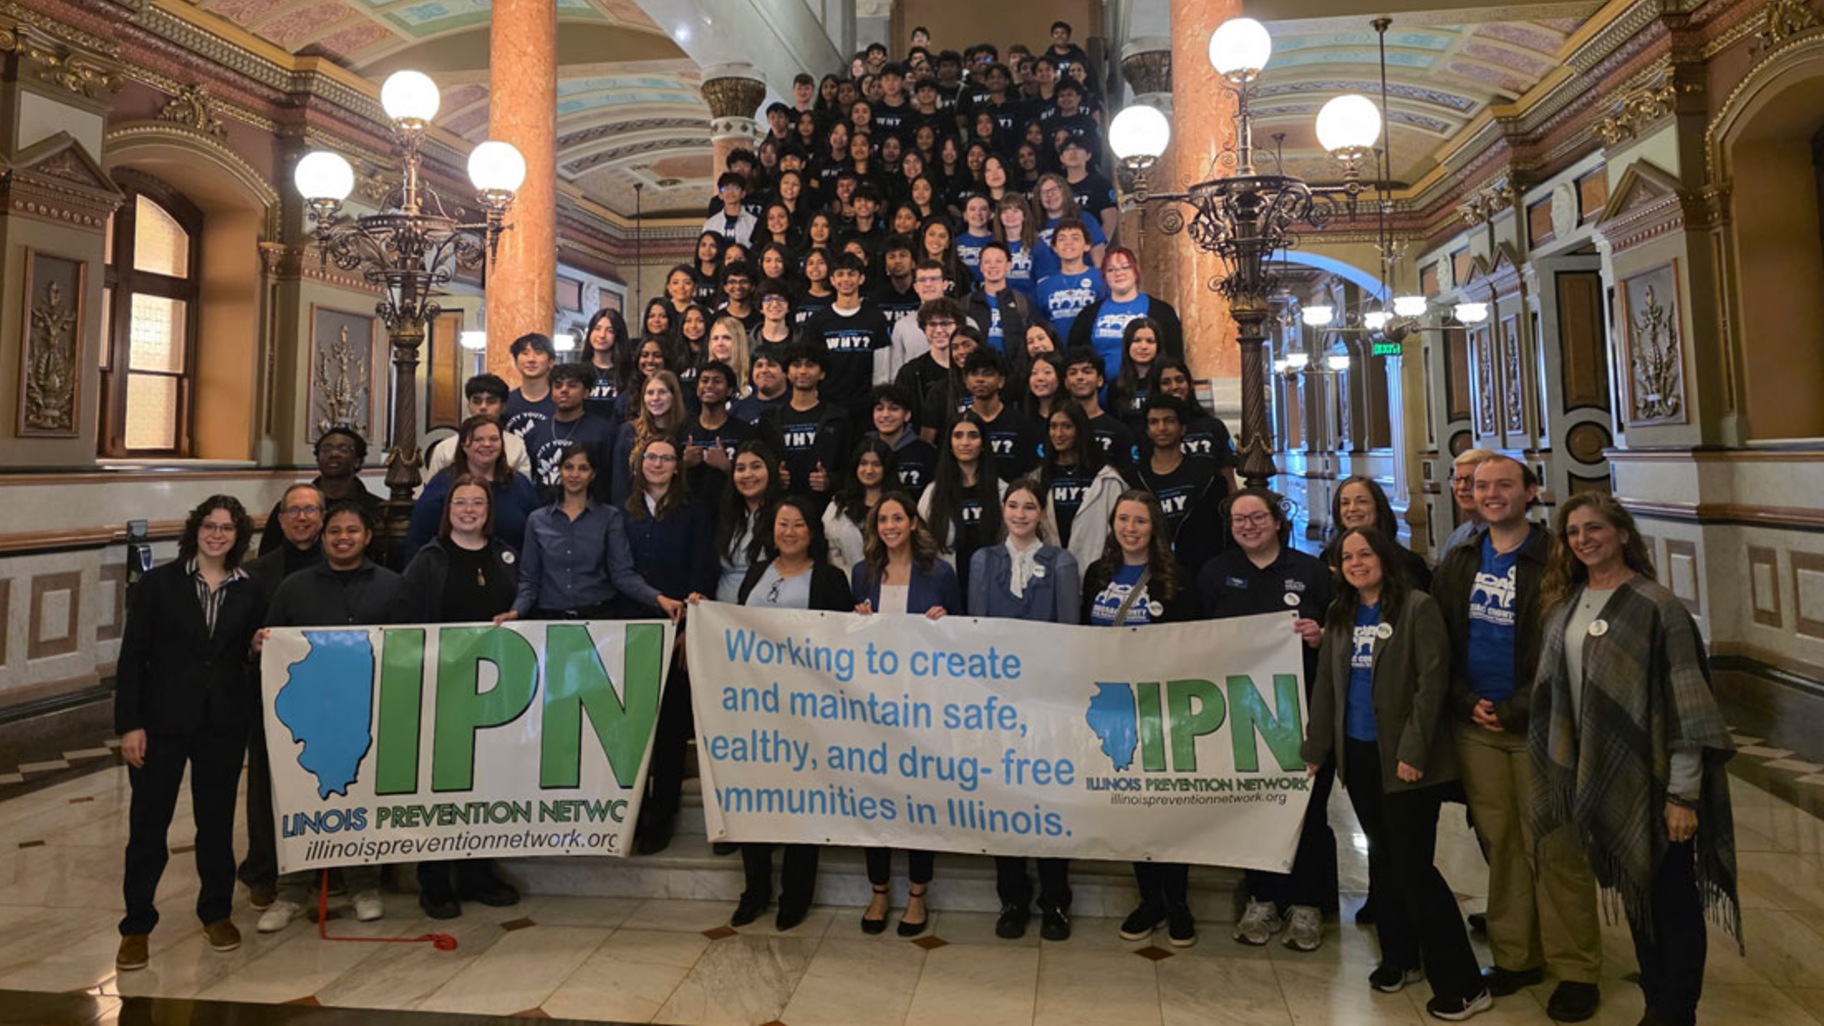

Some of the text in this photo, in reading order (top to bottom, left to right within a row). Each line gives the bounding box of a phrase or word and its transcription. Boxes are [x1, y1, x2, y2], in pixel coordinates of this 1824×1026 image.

[826, 336, 870, 349] WHY?
[725, 628, 1021, 682] Working to create
[375, 623, 664, 795] IPN
[722, 682, 1028, 737] and maintain safe,
[1137, 674, 1307, 773] IPN
[704, 729, 1075, 792] ealthy, and drug- free
[1086, 776, 1310, 792] ILLINOIS PREVENTION NETWORK
[376, 799, 532, 829] PREVENTION
[715, 783, 1073, 837] mmunities in Illinois.
[1110, 791, 1287, 807] illinoispreventionnetwork.org
